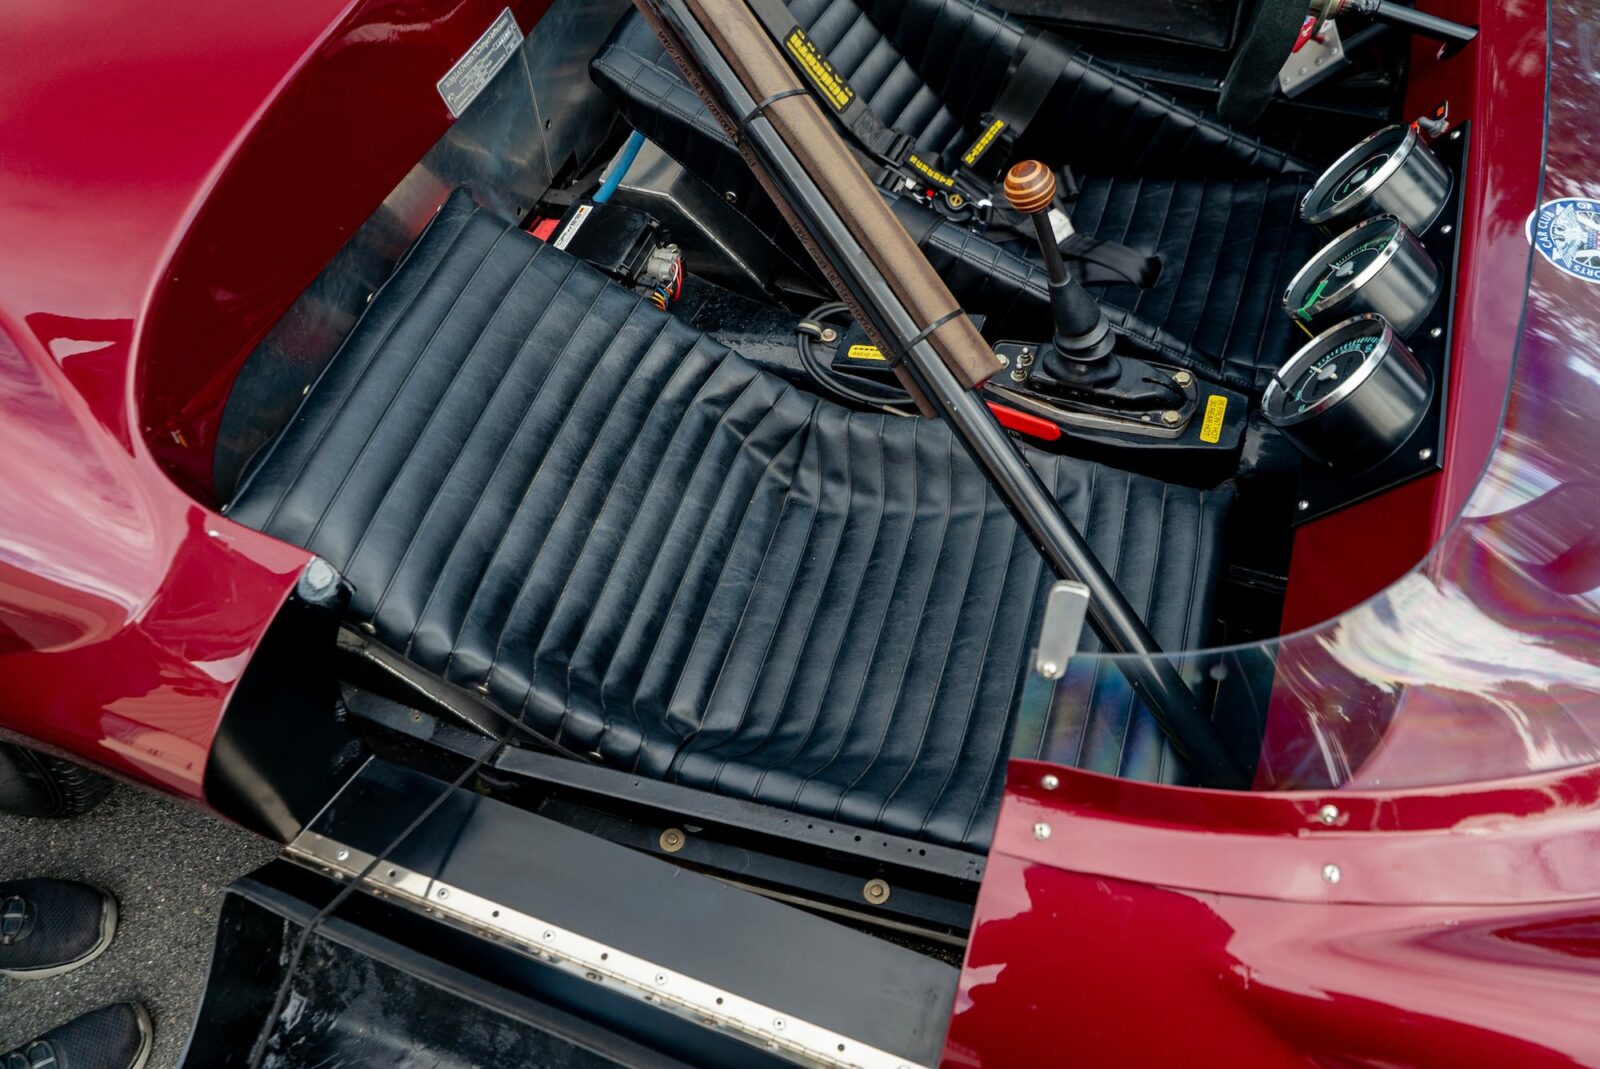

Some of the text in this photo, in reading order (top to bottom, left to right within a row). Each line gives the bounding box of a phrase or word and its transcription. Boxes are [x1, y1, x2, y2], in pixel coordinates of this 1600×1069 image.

[1577, 202, 1592, 210] OF
[1537, 211, 1554, 230] CLUB
[1537, 231, 1553, 248] CAR
[1205, 407, 1215, 423] REAR
[1213, 406, 1223, 426] FRONT
[1202, 423, 1211, 436] HOT
[1210, 426, 1219, 439] HOT
